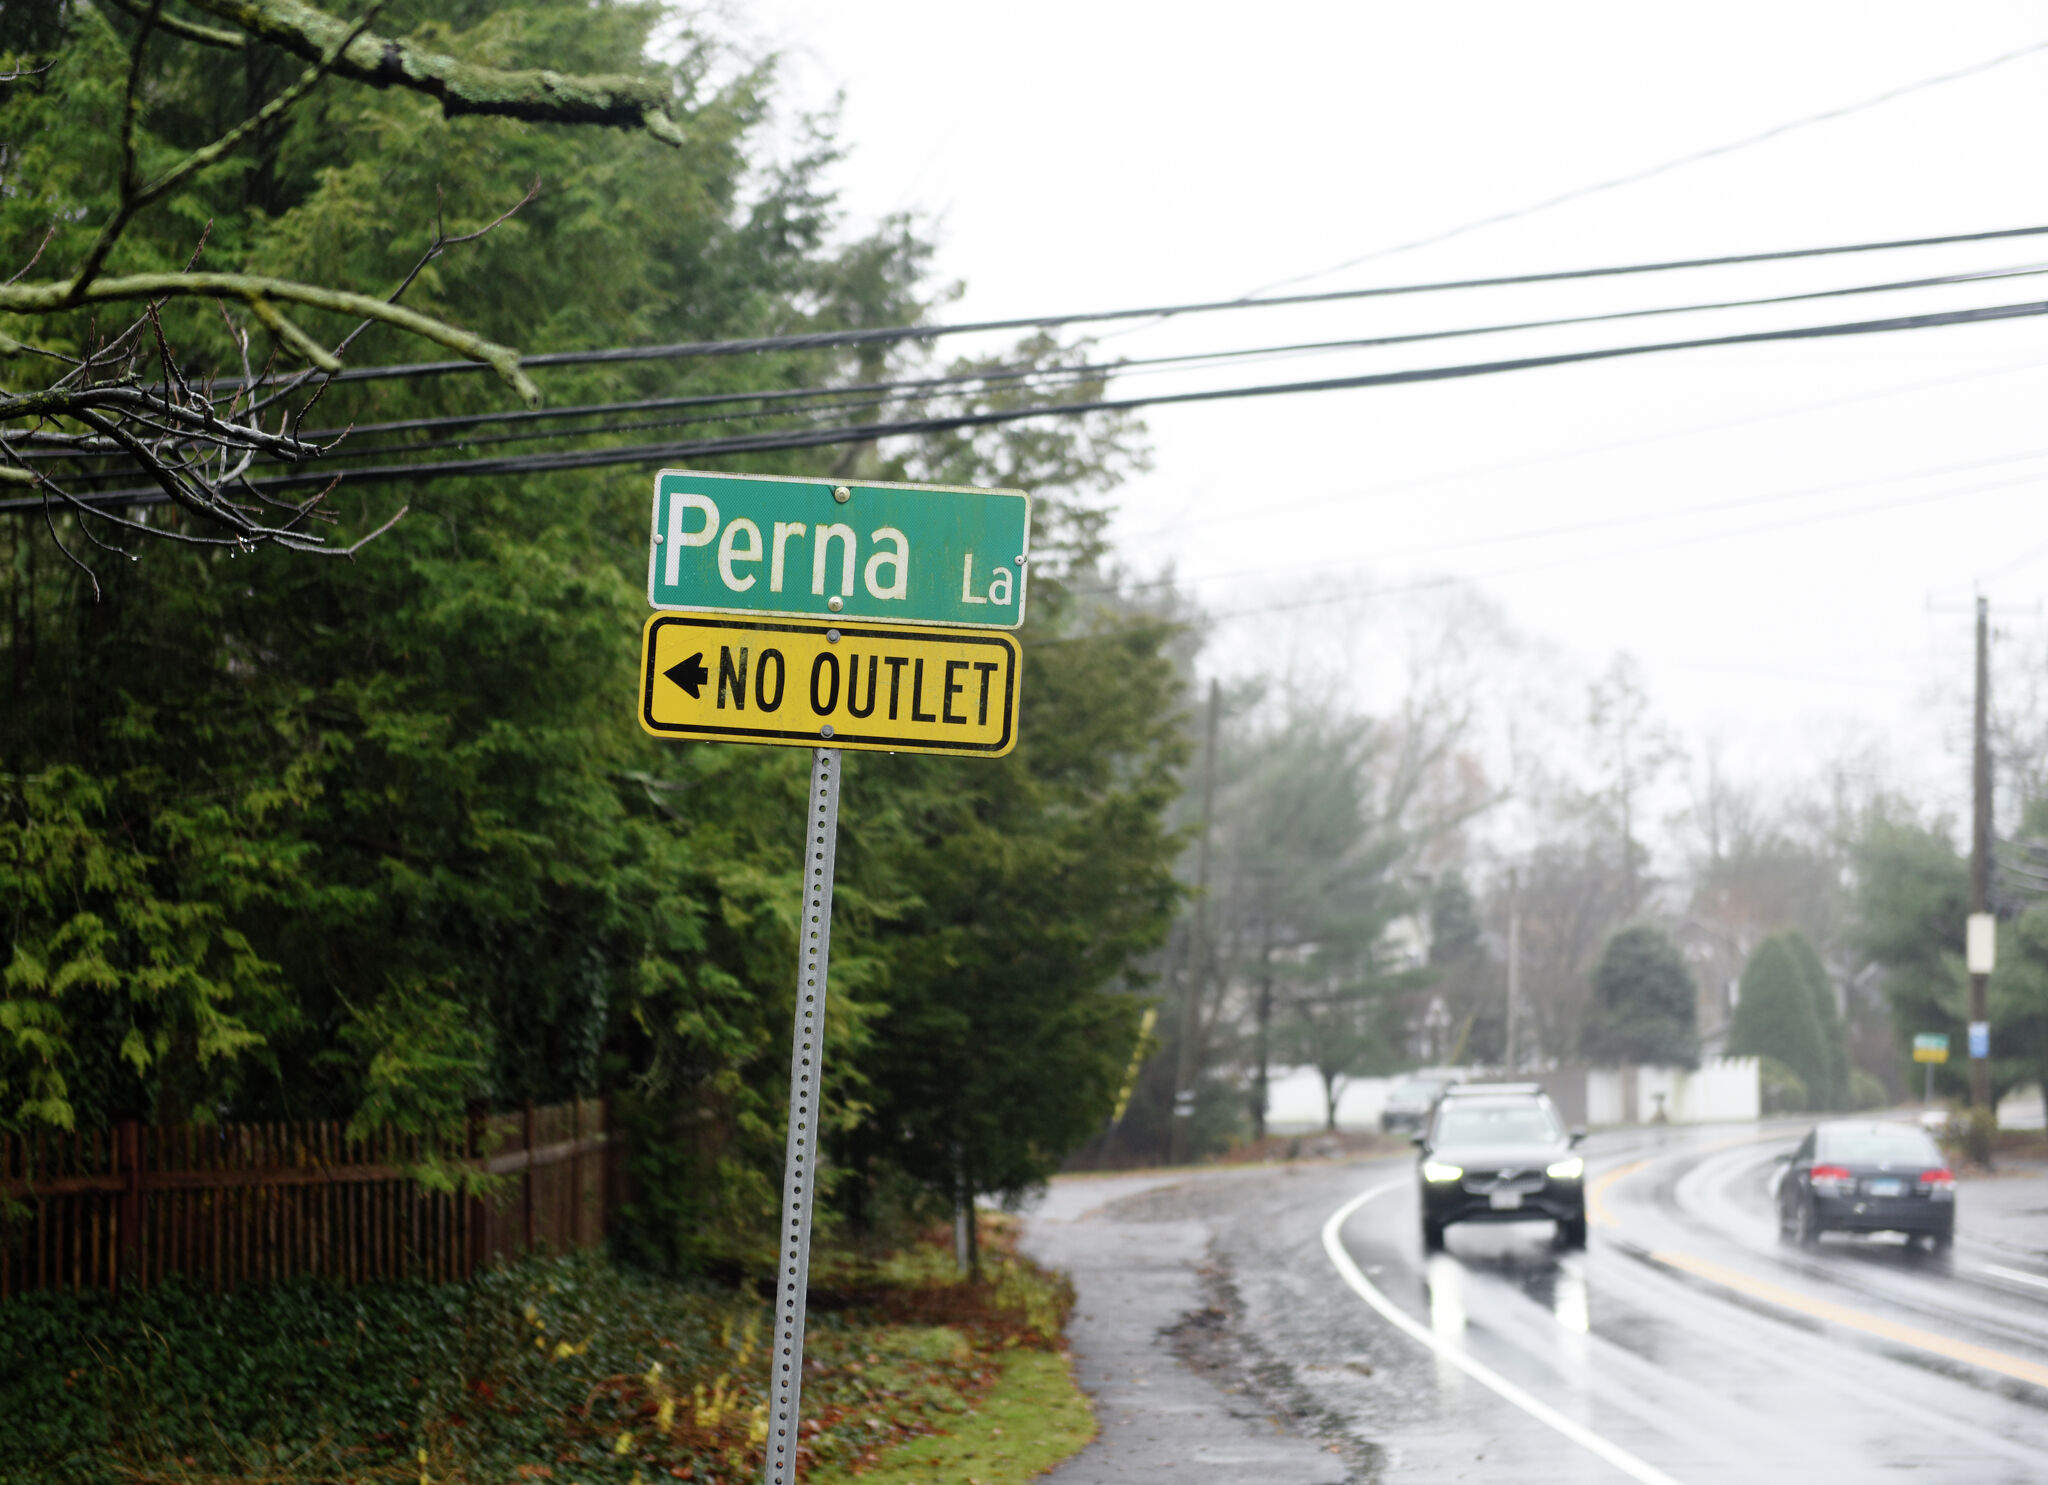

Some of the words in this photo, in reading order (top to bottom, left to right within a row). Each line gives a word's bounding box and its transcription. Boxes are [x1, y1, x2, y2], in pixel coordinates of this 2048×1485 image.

[664, 493, 910, 600] Perna
[961, 553, 1013, 606] La
[716, 645, 786, 713] NO
[810, 651, 998, 726] OUTLET
